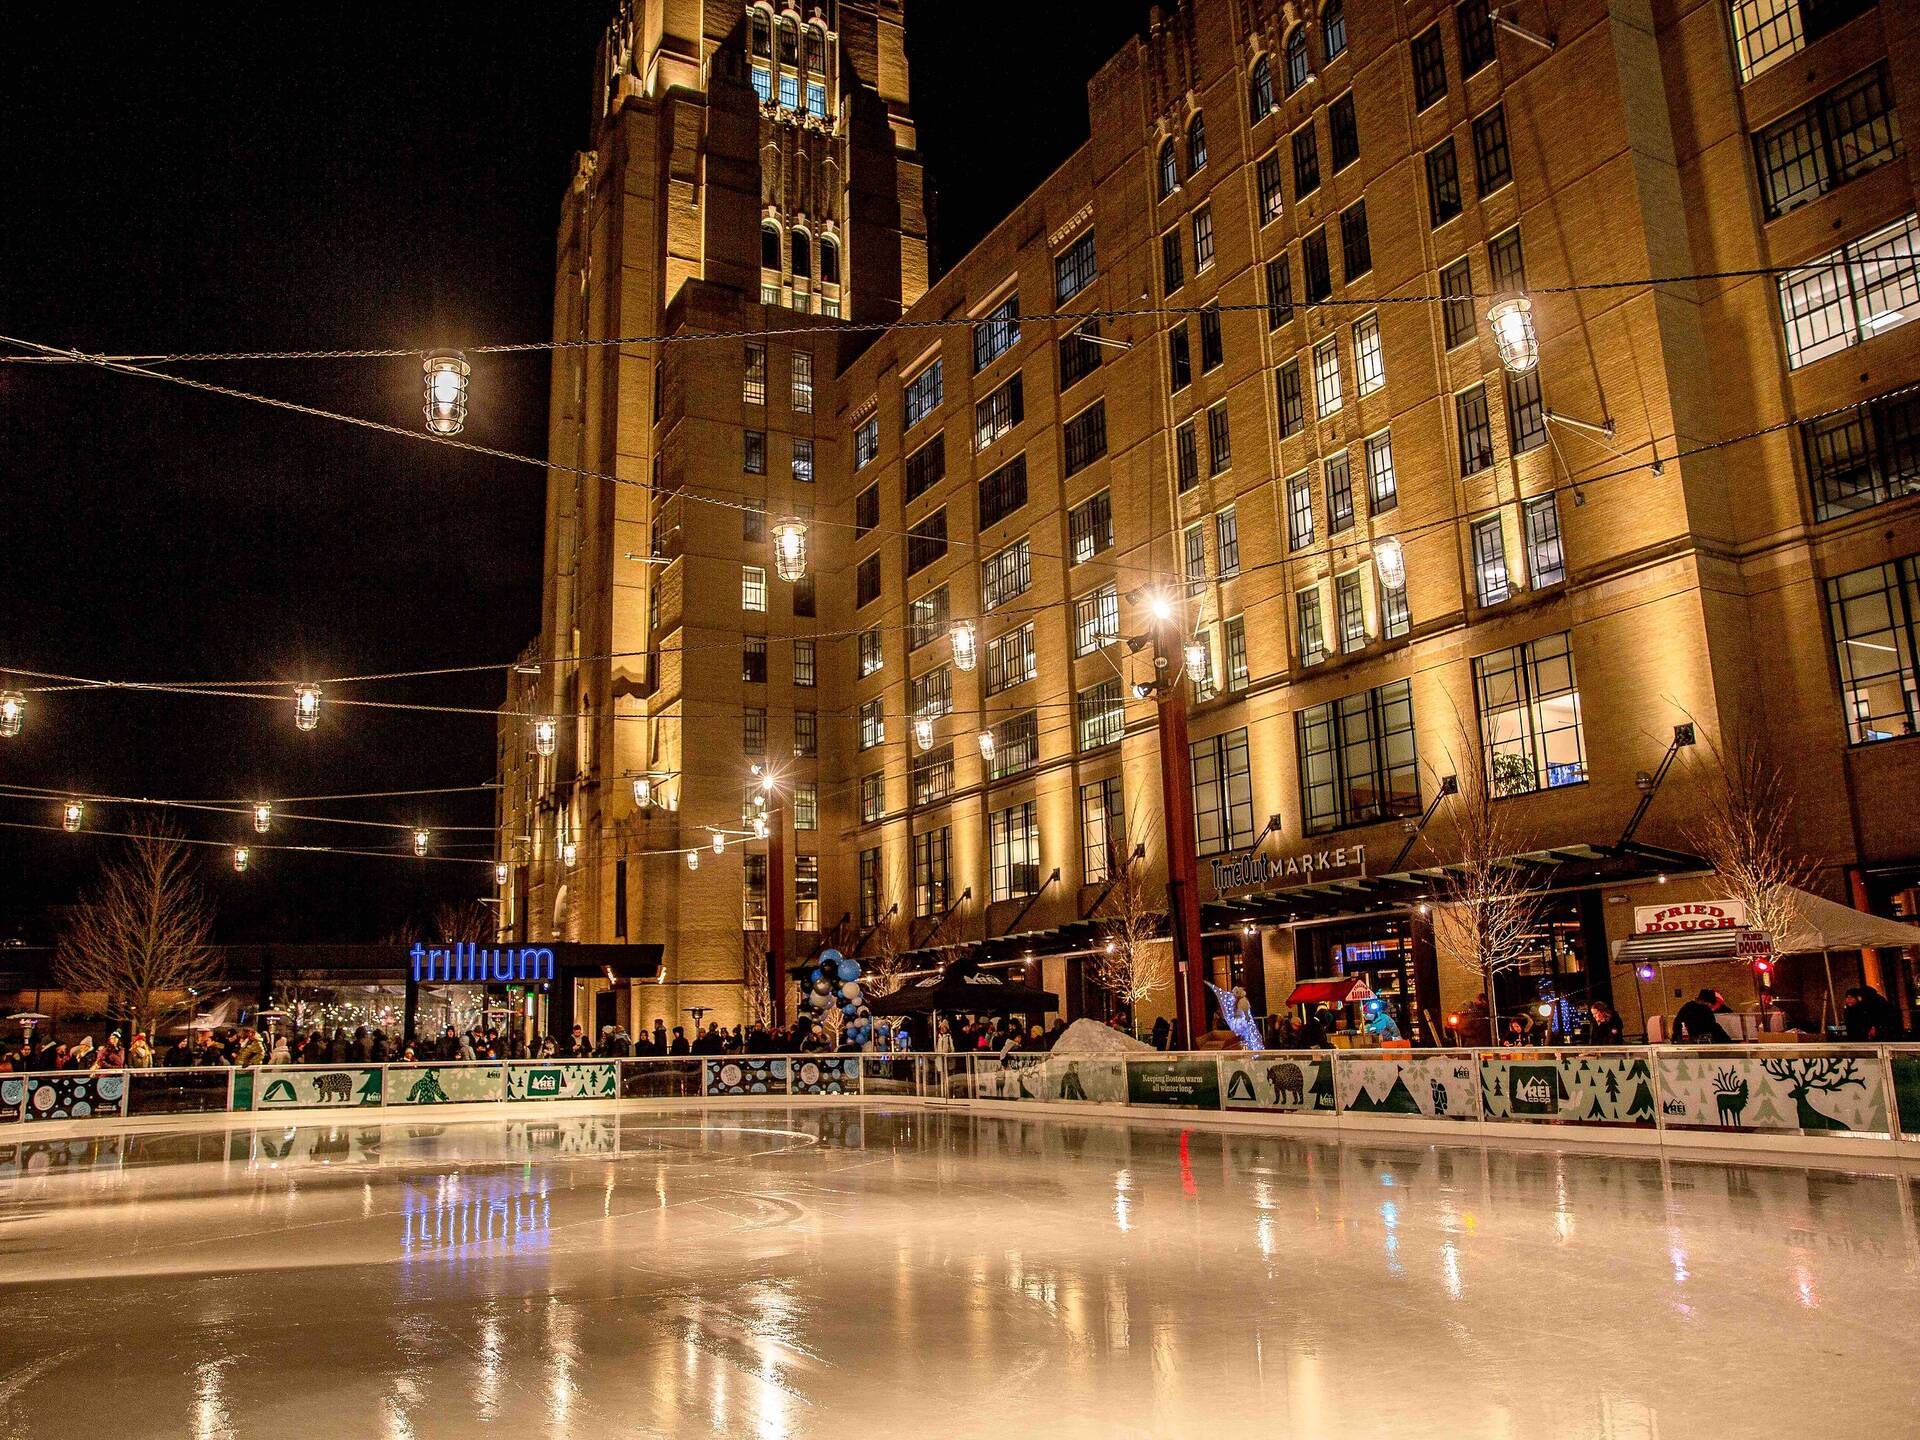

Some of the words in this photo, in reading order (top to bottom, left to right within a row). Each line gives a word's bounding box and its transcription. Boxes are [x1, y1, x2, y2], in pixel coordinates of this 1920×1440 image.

[1270, 844, 1366, 878] MARKET
[1654, 904, 1725, 922] FRIED
[1645, 917, 1736, 933] DOUGH
[1738, 941, 1772, 954] DOUGH
[410, 942, 554, 981] trillium
[1142, 1074, 1165, 1084] Keeping
[1165, 1074, 1186, 1083] Boston
[1152, 1084, 1160, 1092] all
[1160, 1084, 1179, 1092] winter
